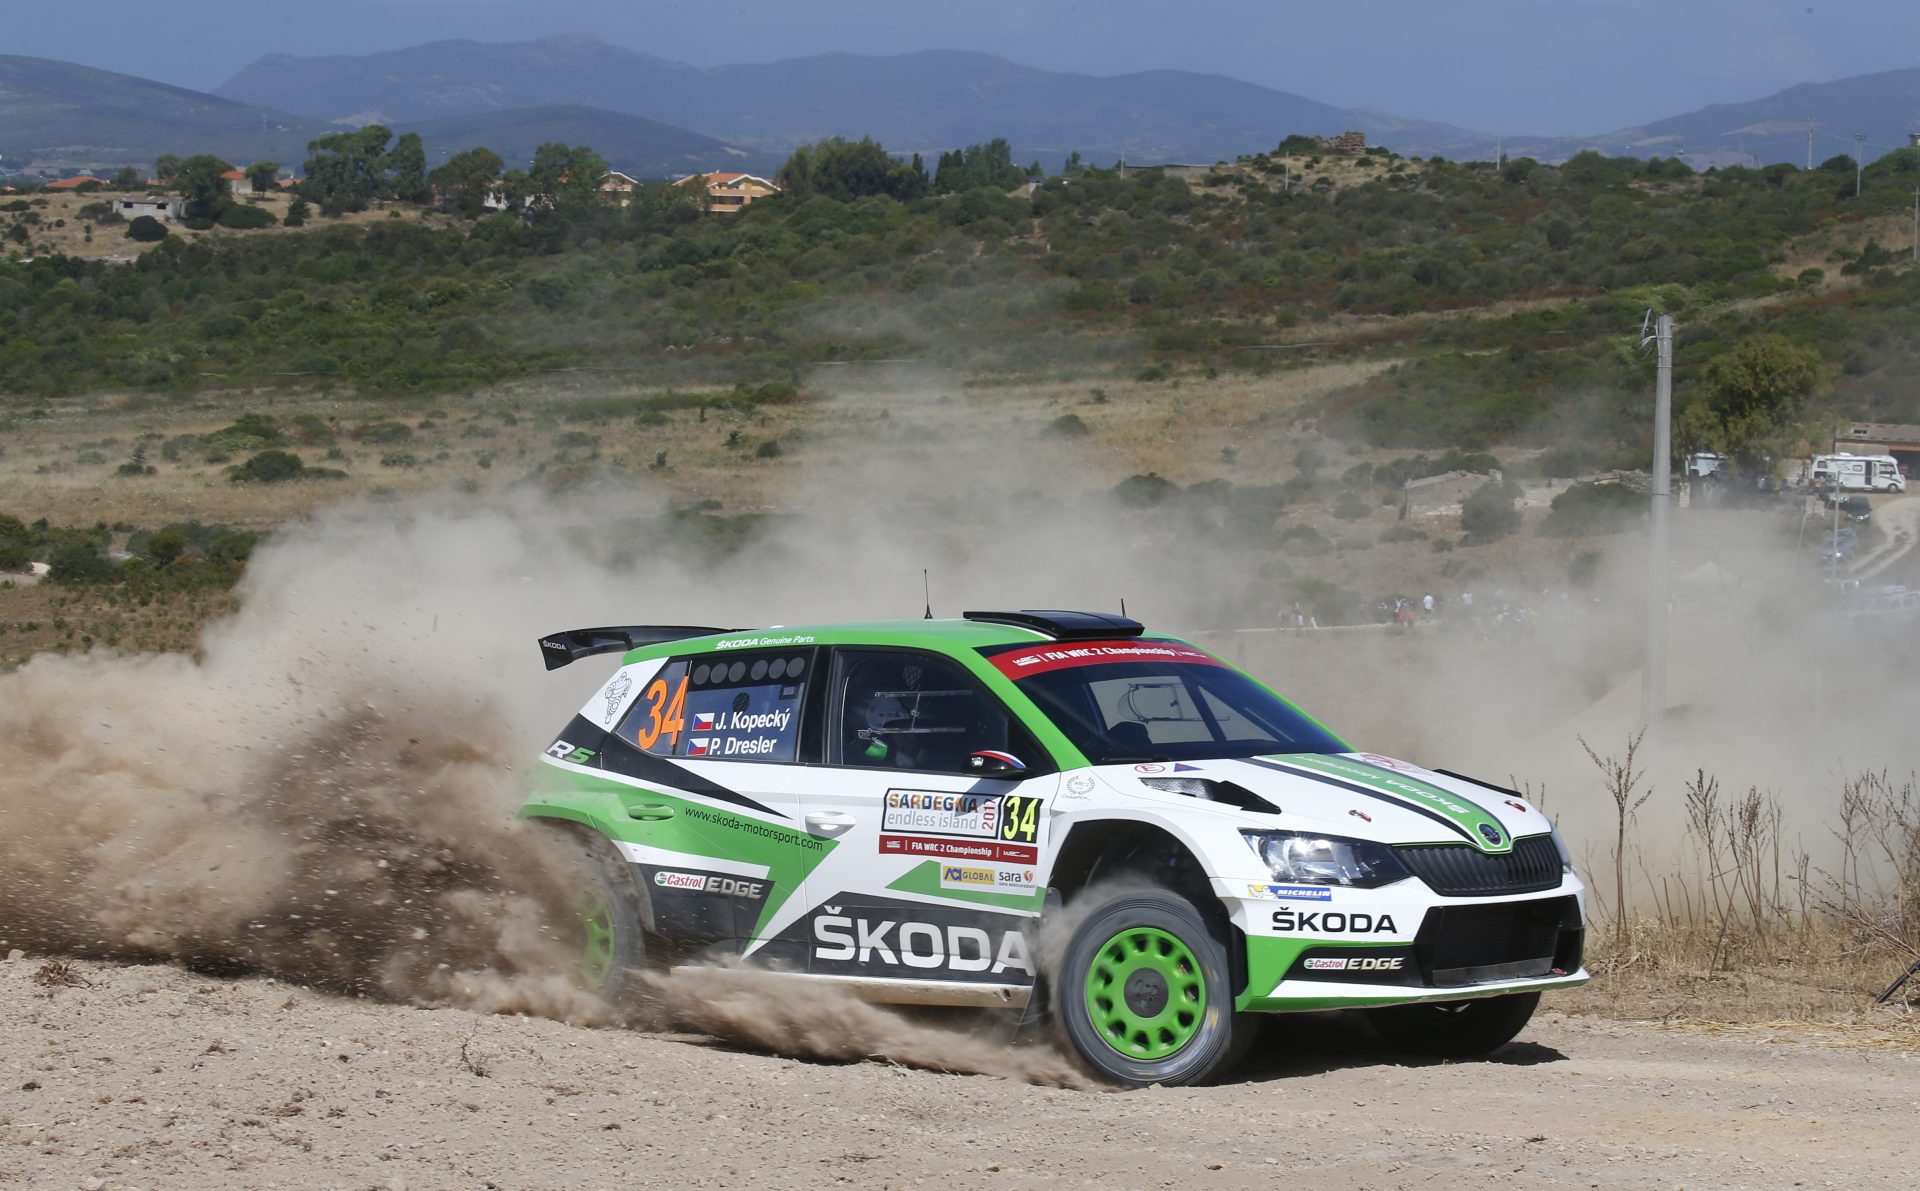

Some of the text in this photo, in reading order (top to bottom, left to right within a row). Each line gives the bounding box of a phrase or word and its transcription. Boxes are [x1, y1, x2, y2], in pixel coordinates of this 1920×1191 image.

[542, 639, 567, 651] ŠKODA
[716, 635, 815, 650] ŠKODA Genuine Parts
[1048, 651, 1069, 661] FIA
[1065, 647, 1095, 658] WRC
[1093, 648, 1104, 656] 2
[1102, 647, 1176, 657] Championship
[637, 675, 689, 750] 34
[715, 708, 791, 732] J. Kopecký
[545, 740, 596, 763] R5
[709, 736, 777, 756] P. Dresler
[888, 793, 978, 813] SARDEGNA
[685, 806, 823, 851] www.skoda-motorsport.com
[887, 812, 978, 830] endless island
[1003, 796, 1039, 841] 34
[911, 842, 992, 857] FIA WRC 2 Championship
[666, 874, 764, 899] Castrol EDGE
[962, 871, 995, 882] GLOBAL
[999, 871, 1022, 883] sara
[1277, 889, 1331, 897] MICHELIN
[1272, 907, 1398, 934] ŠKODA
[814, 905, 1036, 977] ŠKODA
[1314, 957, 1405, 970] Castrol EDGE
